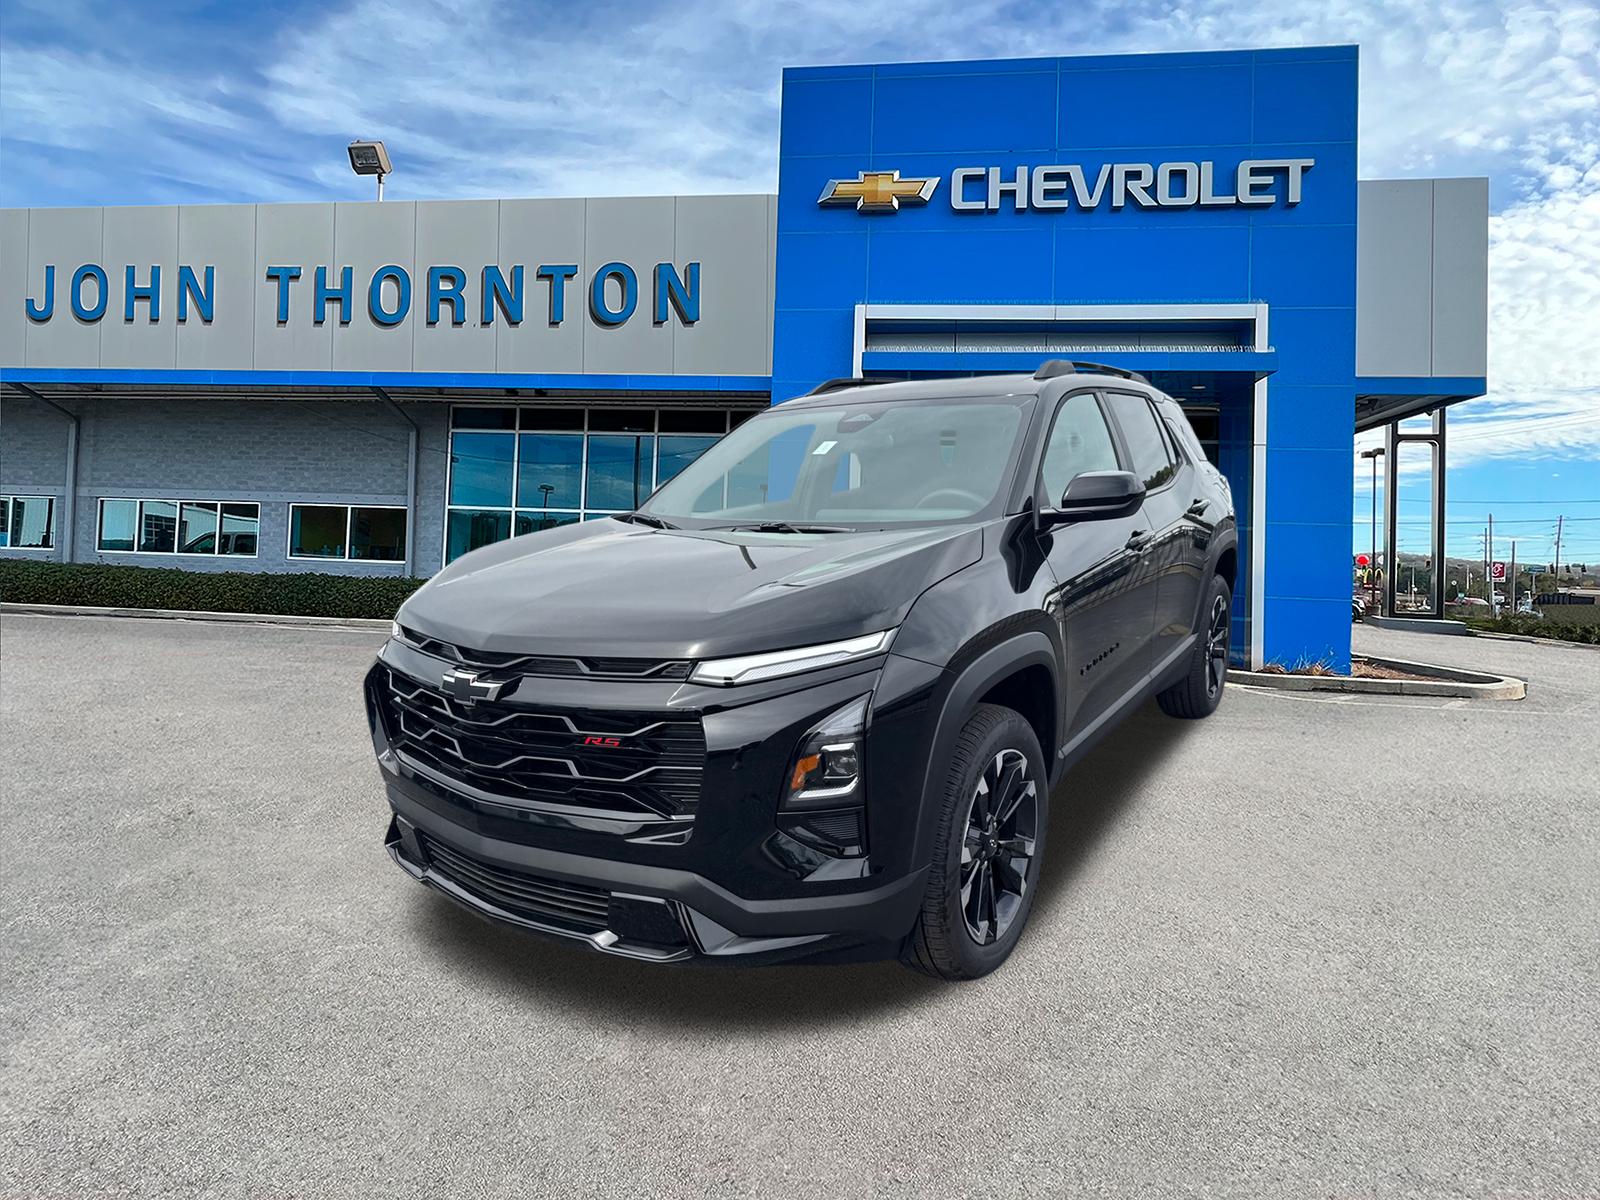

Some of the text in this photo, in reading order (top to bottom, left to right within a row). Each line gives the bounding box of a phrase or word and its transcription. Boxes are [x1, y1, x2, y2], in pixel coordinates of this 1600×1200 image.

[951, 158, 1316, 212] CHEVROLET
[26, 261, 702, 327] JOHN THORNTON
[584, 736, 621, 748] RS
